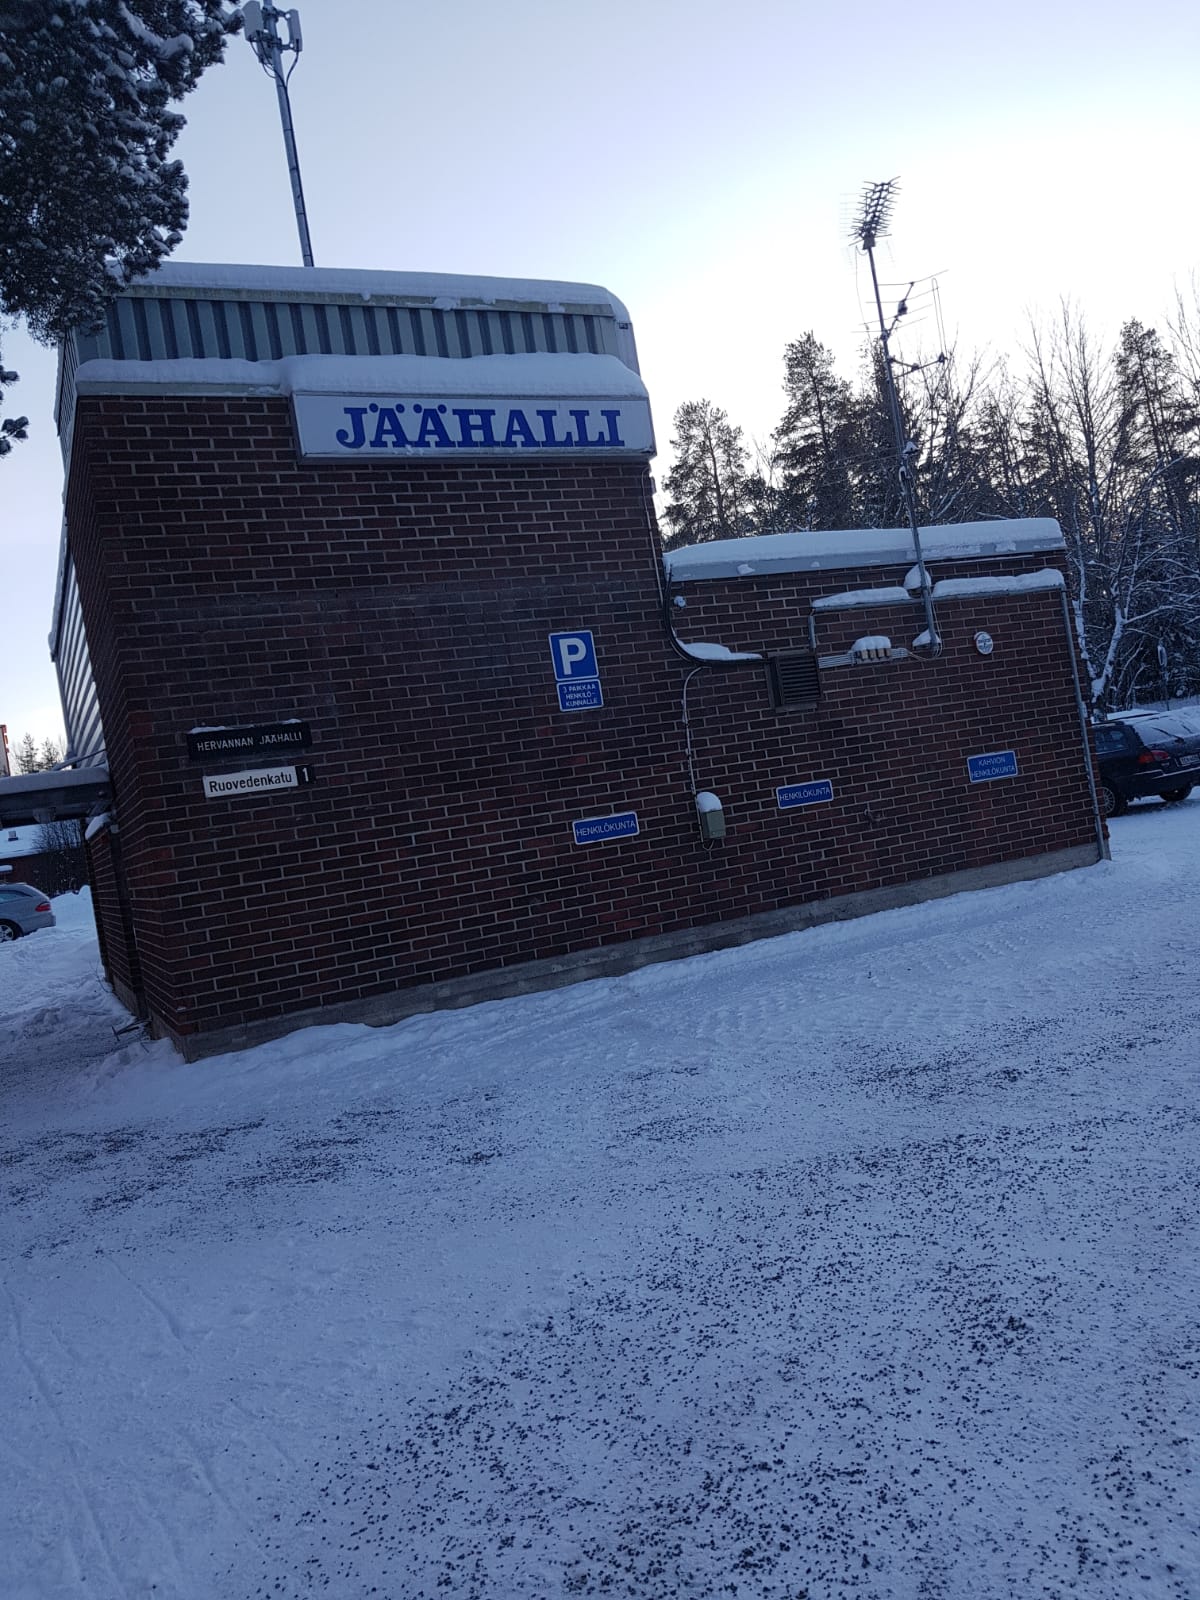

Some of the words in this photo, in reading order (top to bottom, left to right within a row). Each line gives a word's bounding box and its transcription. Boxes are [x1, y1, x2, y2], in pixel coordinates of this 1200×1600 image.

[336, 403, 625, 449] JÄÄHALLI
[558, 637, 587, 675] P
[568, 683, 596, 692] PAIKKAA
[565, 697, 598, 707] KUNNALLE
[196, 737, 254, 751] HERVANNAN
[259, 731, 302, 745] JÄÄHALLI
[978, 755, 1006, 767] KAHVION
[208, 771, 292, 793] Ruovedenkatu
[302, 767, 309, 782] 1
[779, 786, 831, 801] HENKILÖKUNTA
[576, 820, 636, 837] HENKILÖKUNTA
